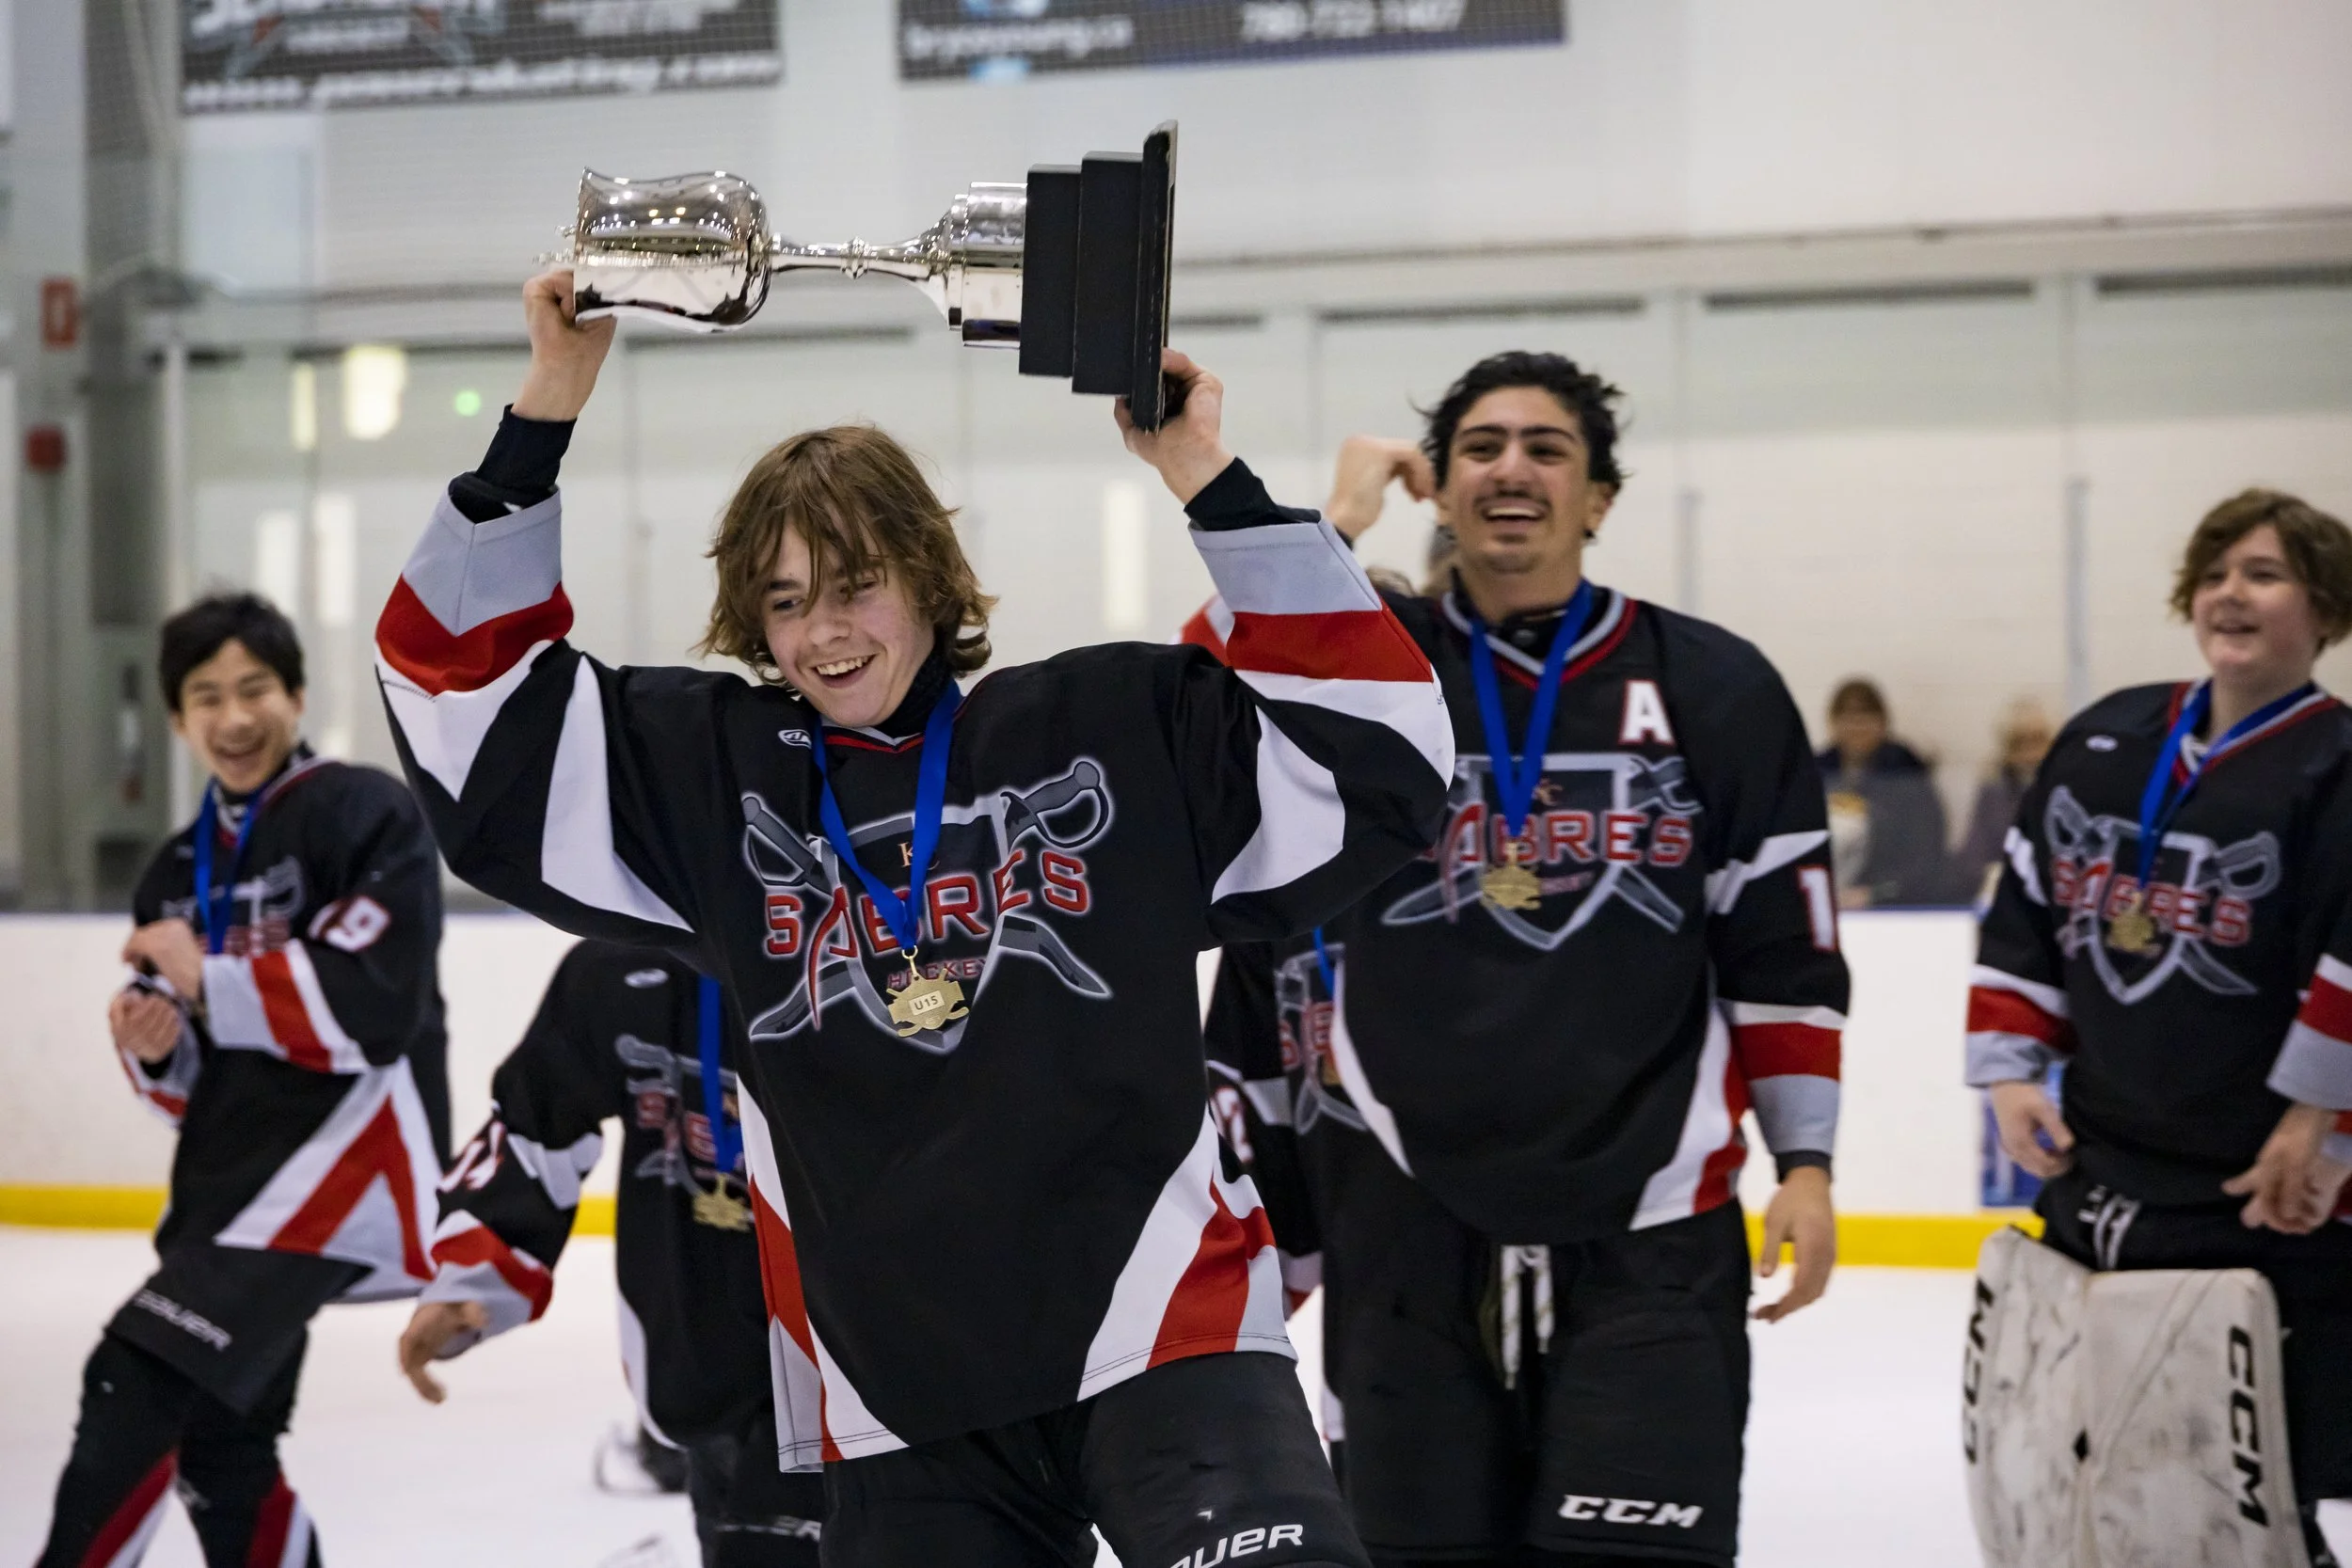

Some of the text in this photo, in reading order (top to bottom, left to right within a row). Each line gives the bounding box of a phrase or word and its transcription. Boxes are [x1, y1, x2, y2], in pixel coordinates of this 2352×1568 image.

[1618, 679, 1676, 746] A
[914, 996, 939, 1010] U15
[2229, 1324, 2270, 1528] CCM
[1557, 1494, 1704, 1528] CCM
